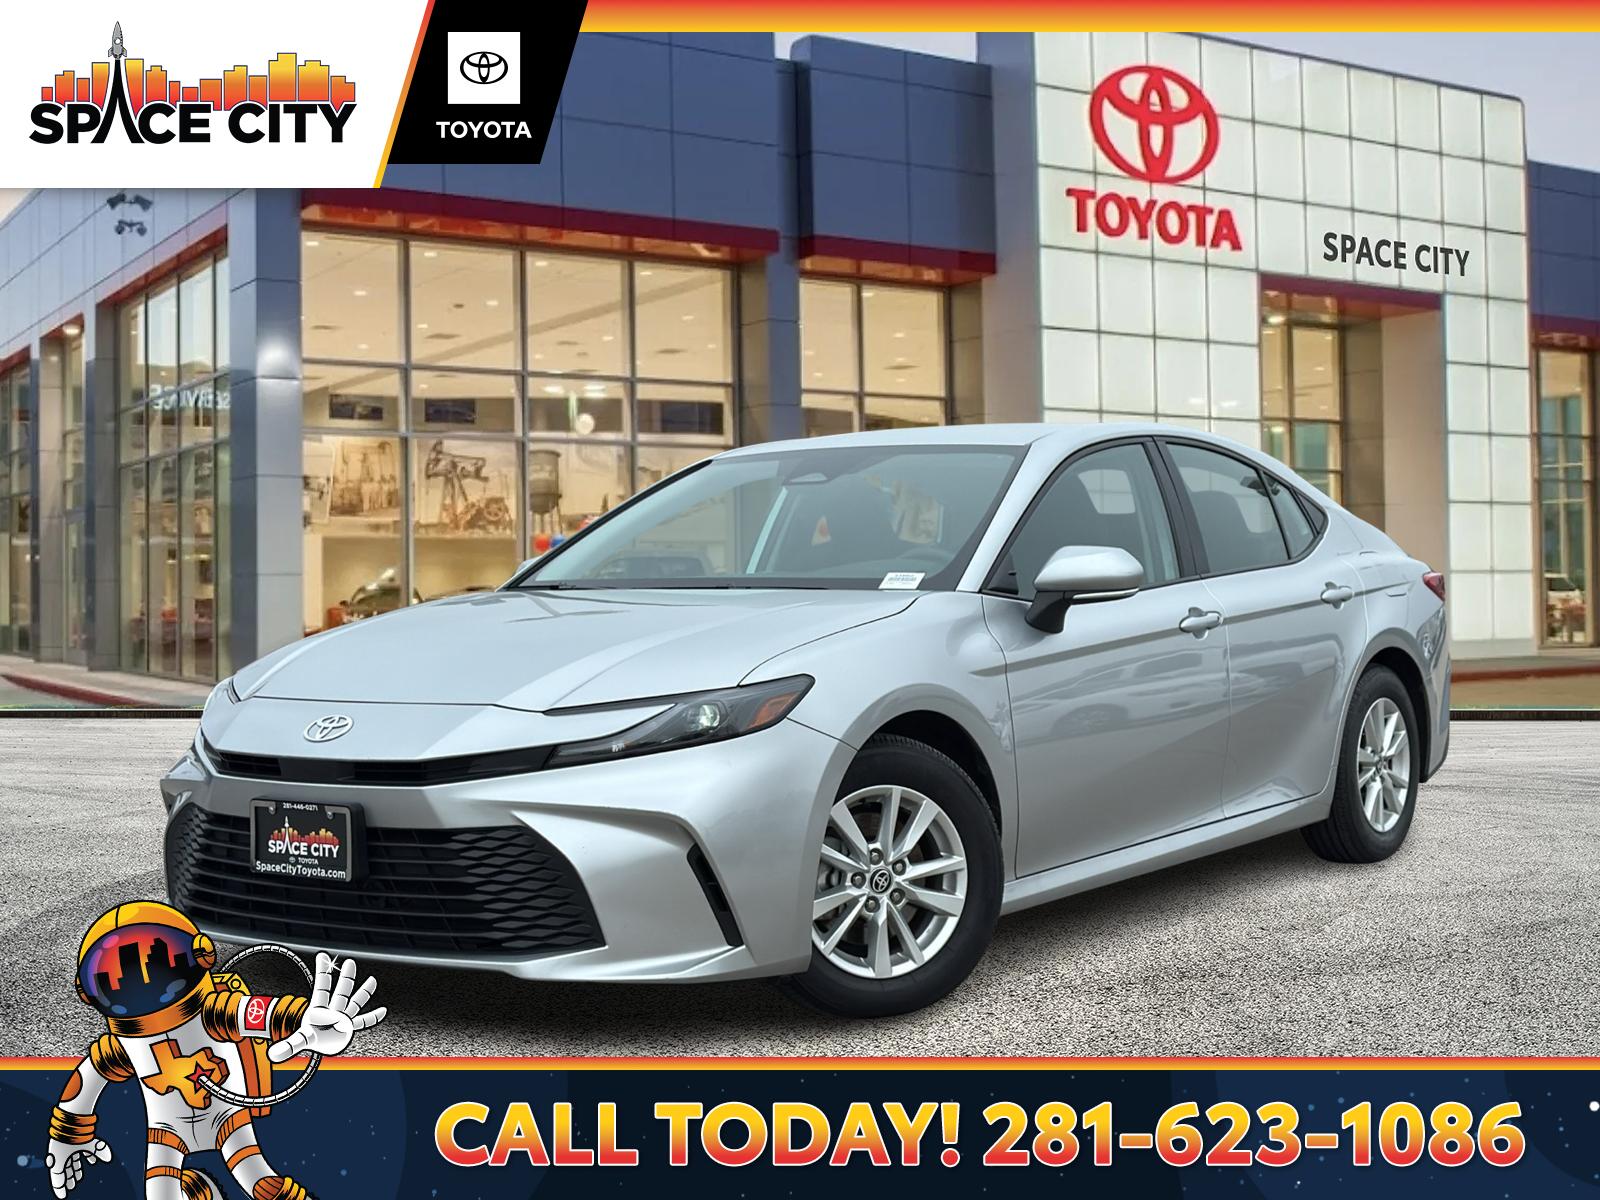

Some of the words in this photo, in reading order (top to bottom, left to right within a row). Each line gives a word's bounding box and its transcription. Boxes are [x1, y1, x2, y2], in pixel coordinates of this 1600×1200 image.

[1065, 188, 1242, 252] TOYOTA
[1323, 232, 1407, 269] SPACE
[1415, 245, 1471, 277] CITY
[268, 837, 308, 855] SPACE
[311, 843, 339, 858] CITY
[256, 861, 346, 879] SpaceCityToyota.com
[298, 857, 318, 865] TOYOTA
